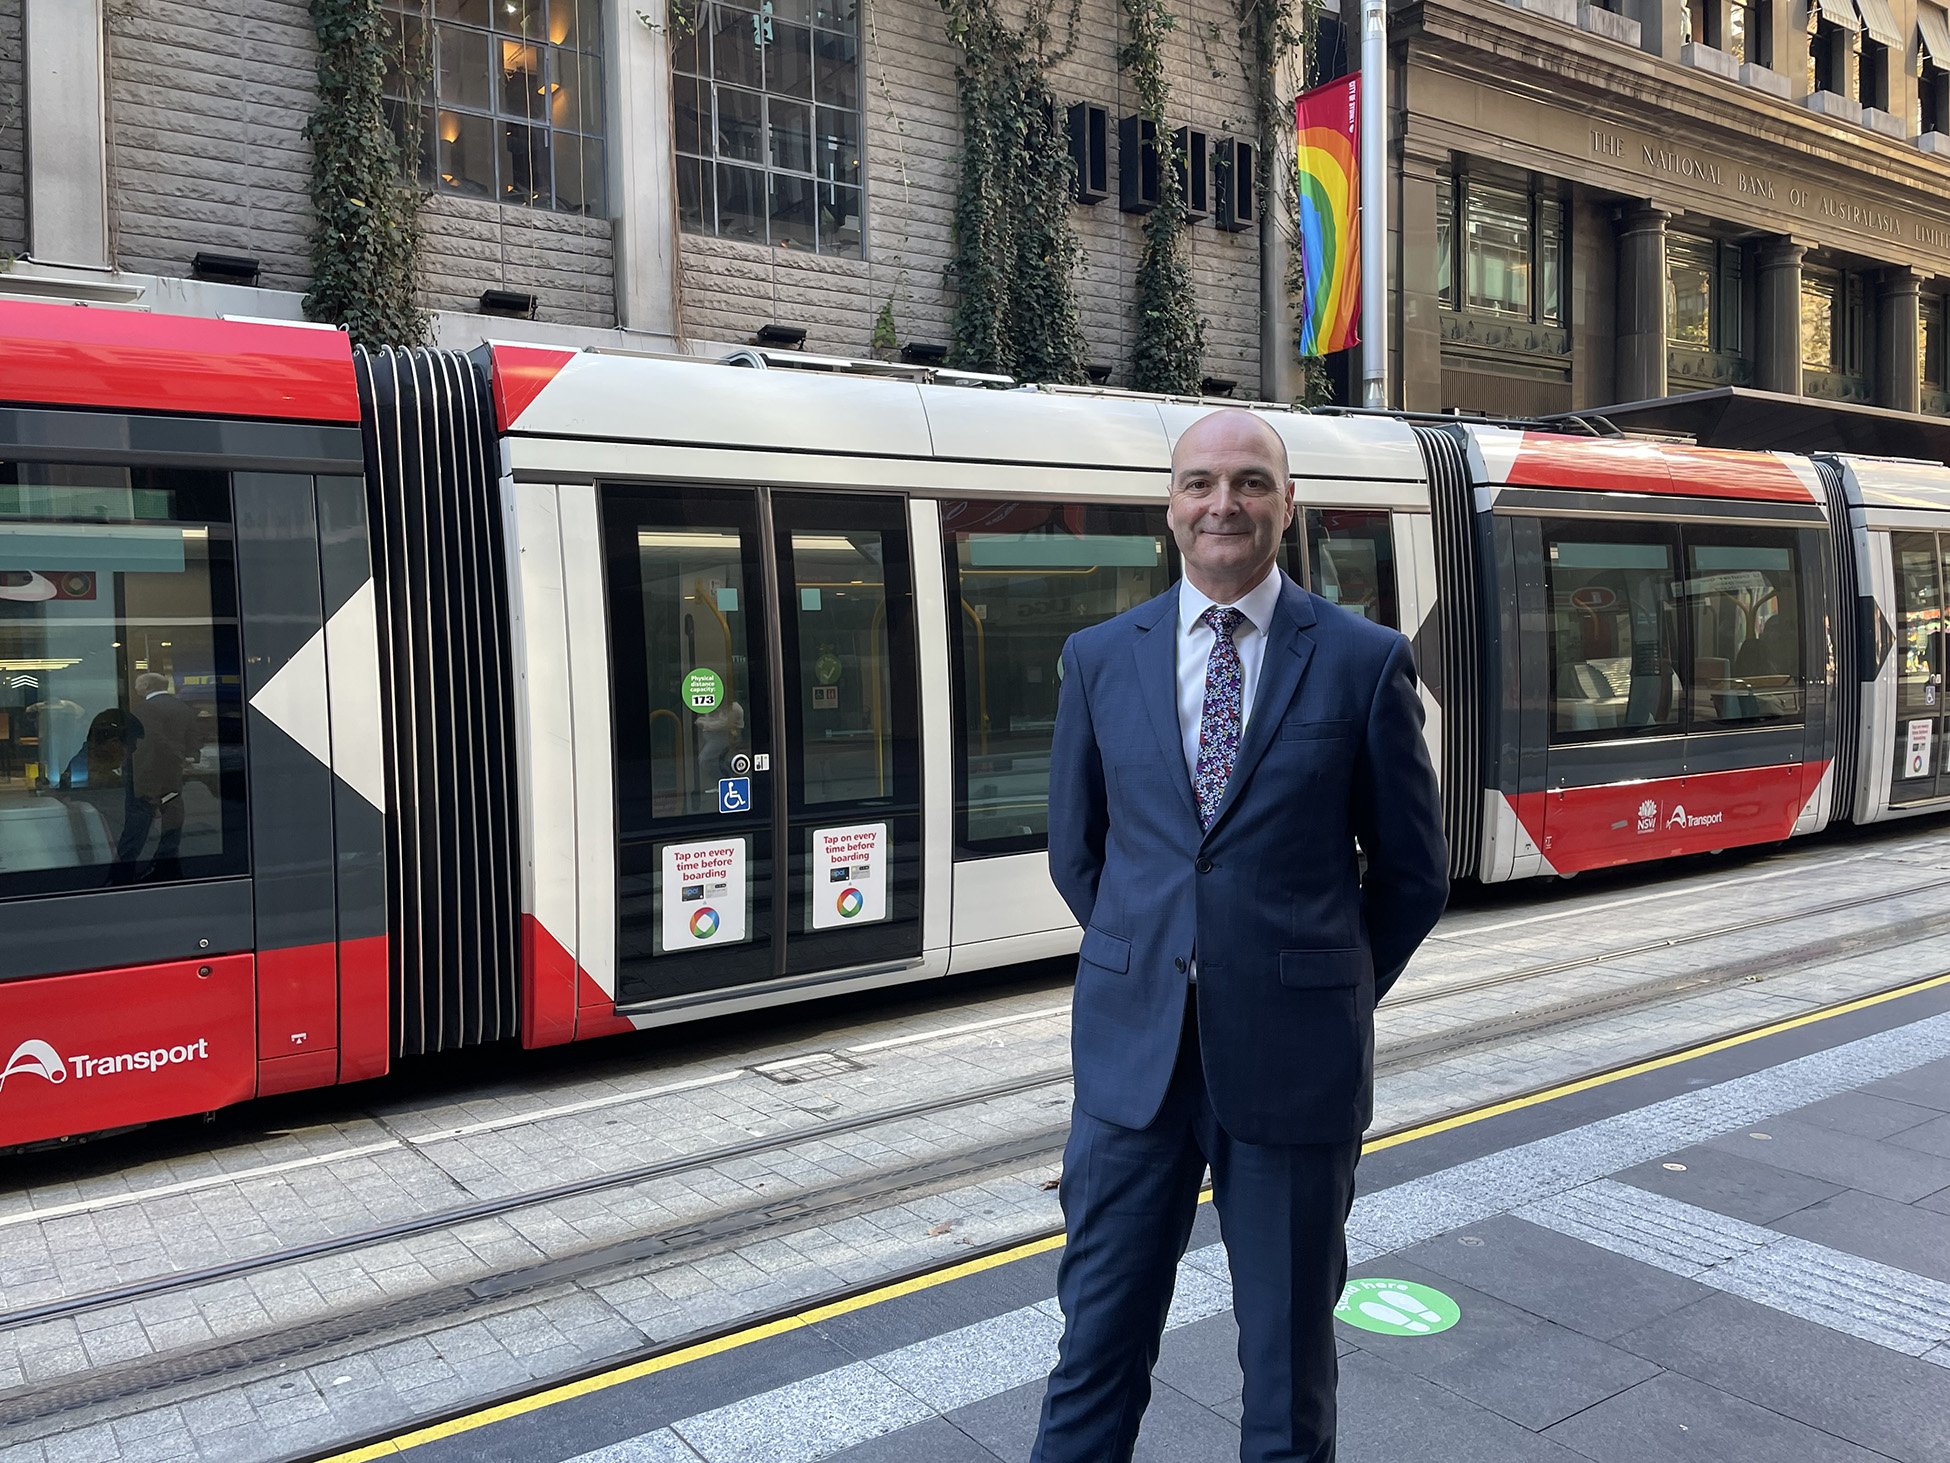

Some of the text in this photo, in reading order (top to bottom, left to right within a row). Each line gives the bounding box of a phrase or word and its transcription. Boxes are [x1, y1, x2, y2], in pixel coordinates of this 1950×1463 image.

[1591, 130, 1624, 158] THE
[1642, 144, 1724, 185] NATIONAL
[1737, 172, 1775, 200] BANK
[1790, 188, 1808, 208] OF
[1820, 197, 1901, 236] AUSTRALASIA
[693, 696, 714, 705] 173
[1637, 817, 1656, 830] NSW
[1687, 811, 1722, 827] Transport
[824, 836, 838, 845] Tap
[853, 832, 877, 840] every
[674, 848, 735, 861] Tap on every
[825, 842, 875, 854] time before
[831, 852, 870, 863] boarding
[676, 858, 733, 871] time before
[682, 869, 727, 881] boarding
[68, 1038, 208, 1078] Transport
